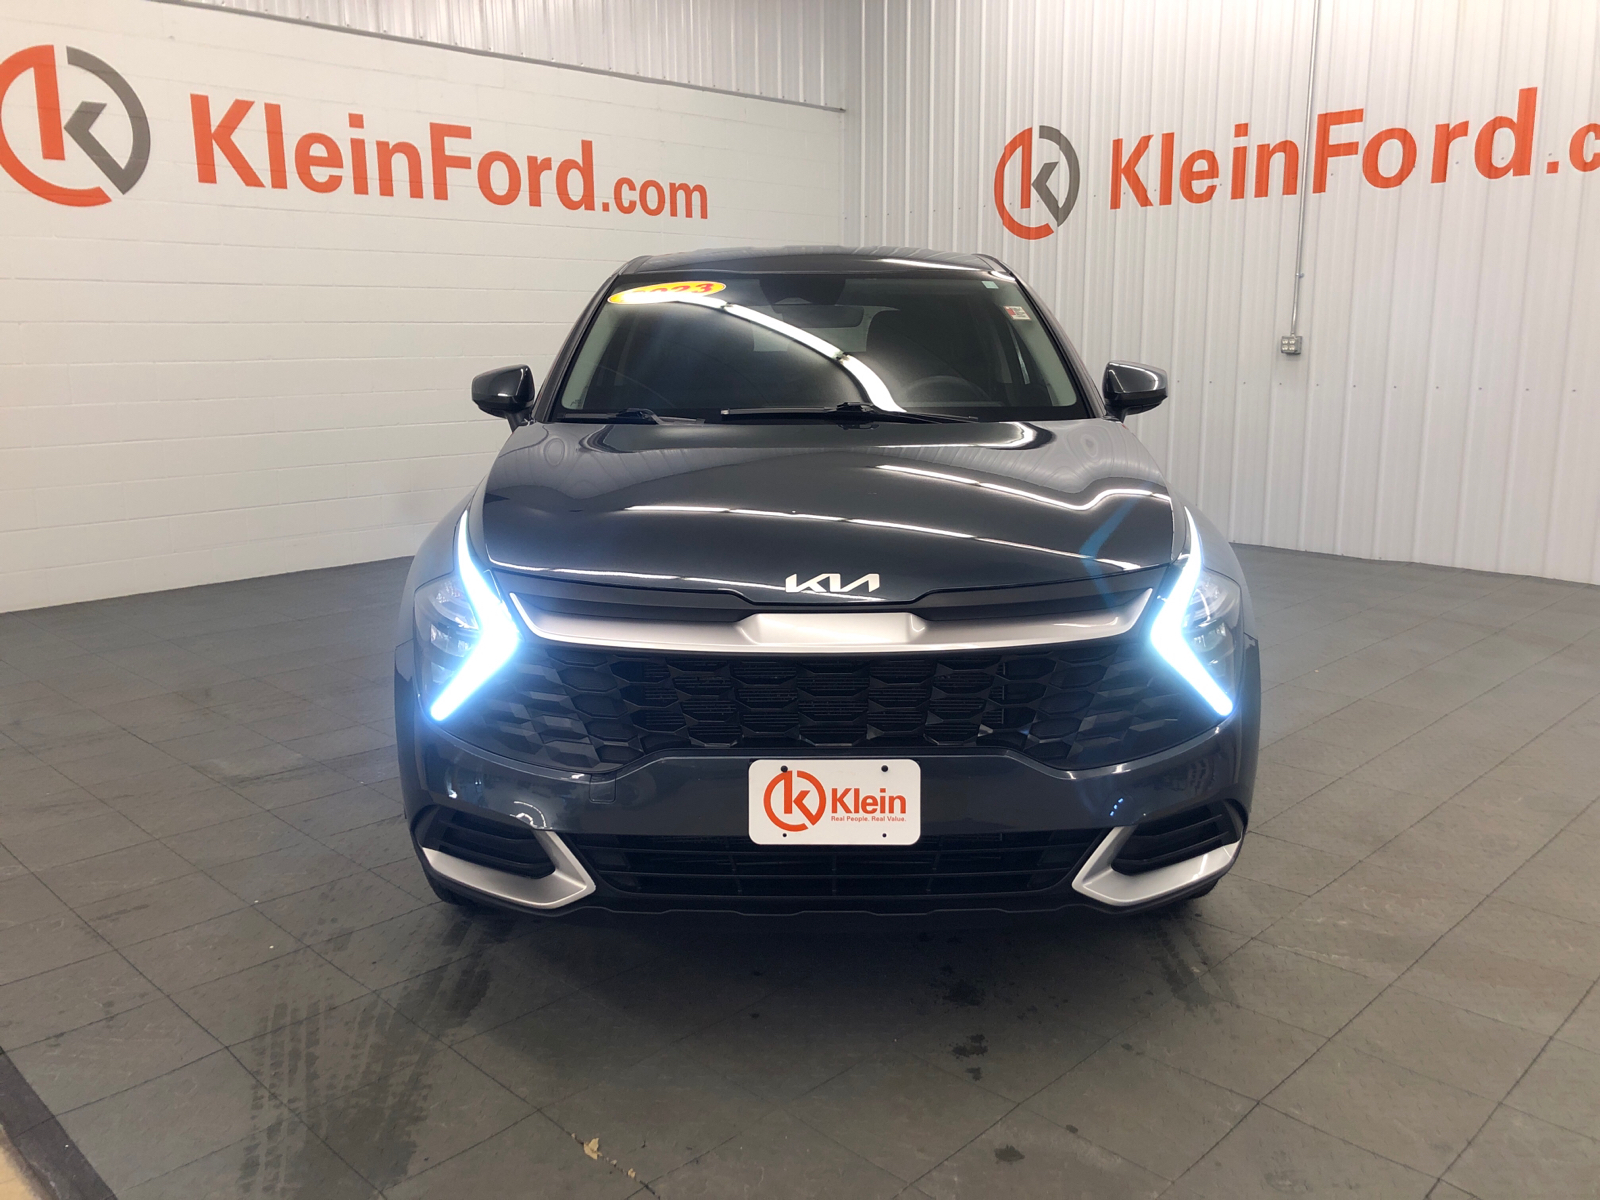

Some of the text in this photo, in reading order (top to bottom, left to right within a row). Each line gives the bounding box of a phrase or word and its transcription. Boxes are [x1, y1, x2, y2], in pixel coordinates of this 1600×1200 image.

[190, 93, 709, 220] KleinFord.com
[785, 573, 880, 593] KIA
[831, 788, 907, 815] Klein
[846, 815, 870, 823] People.
